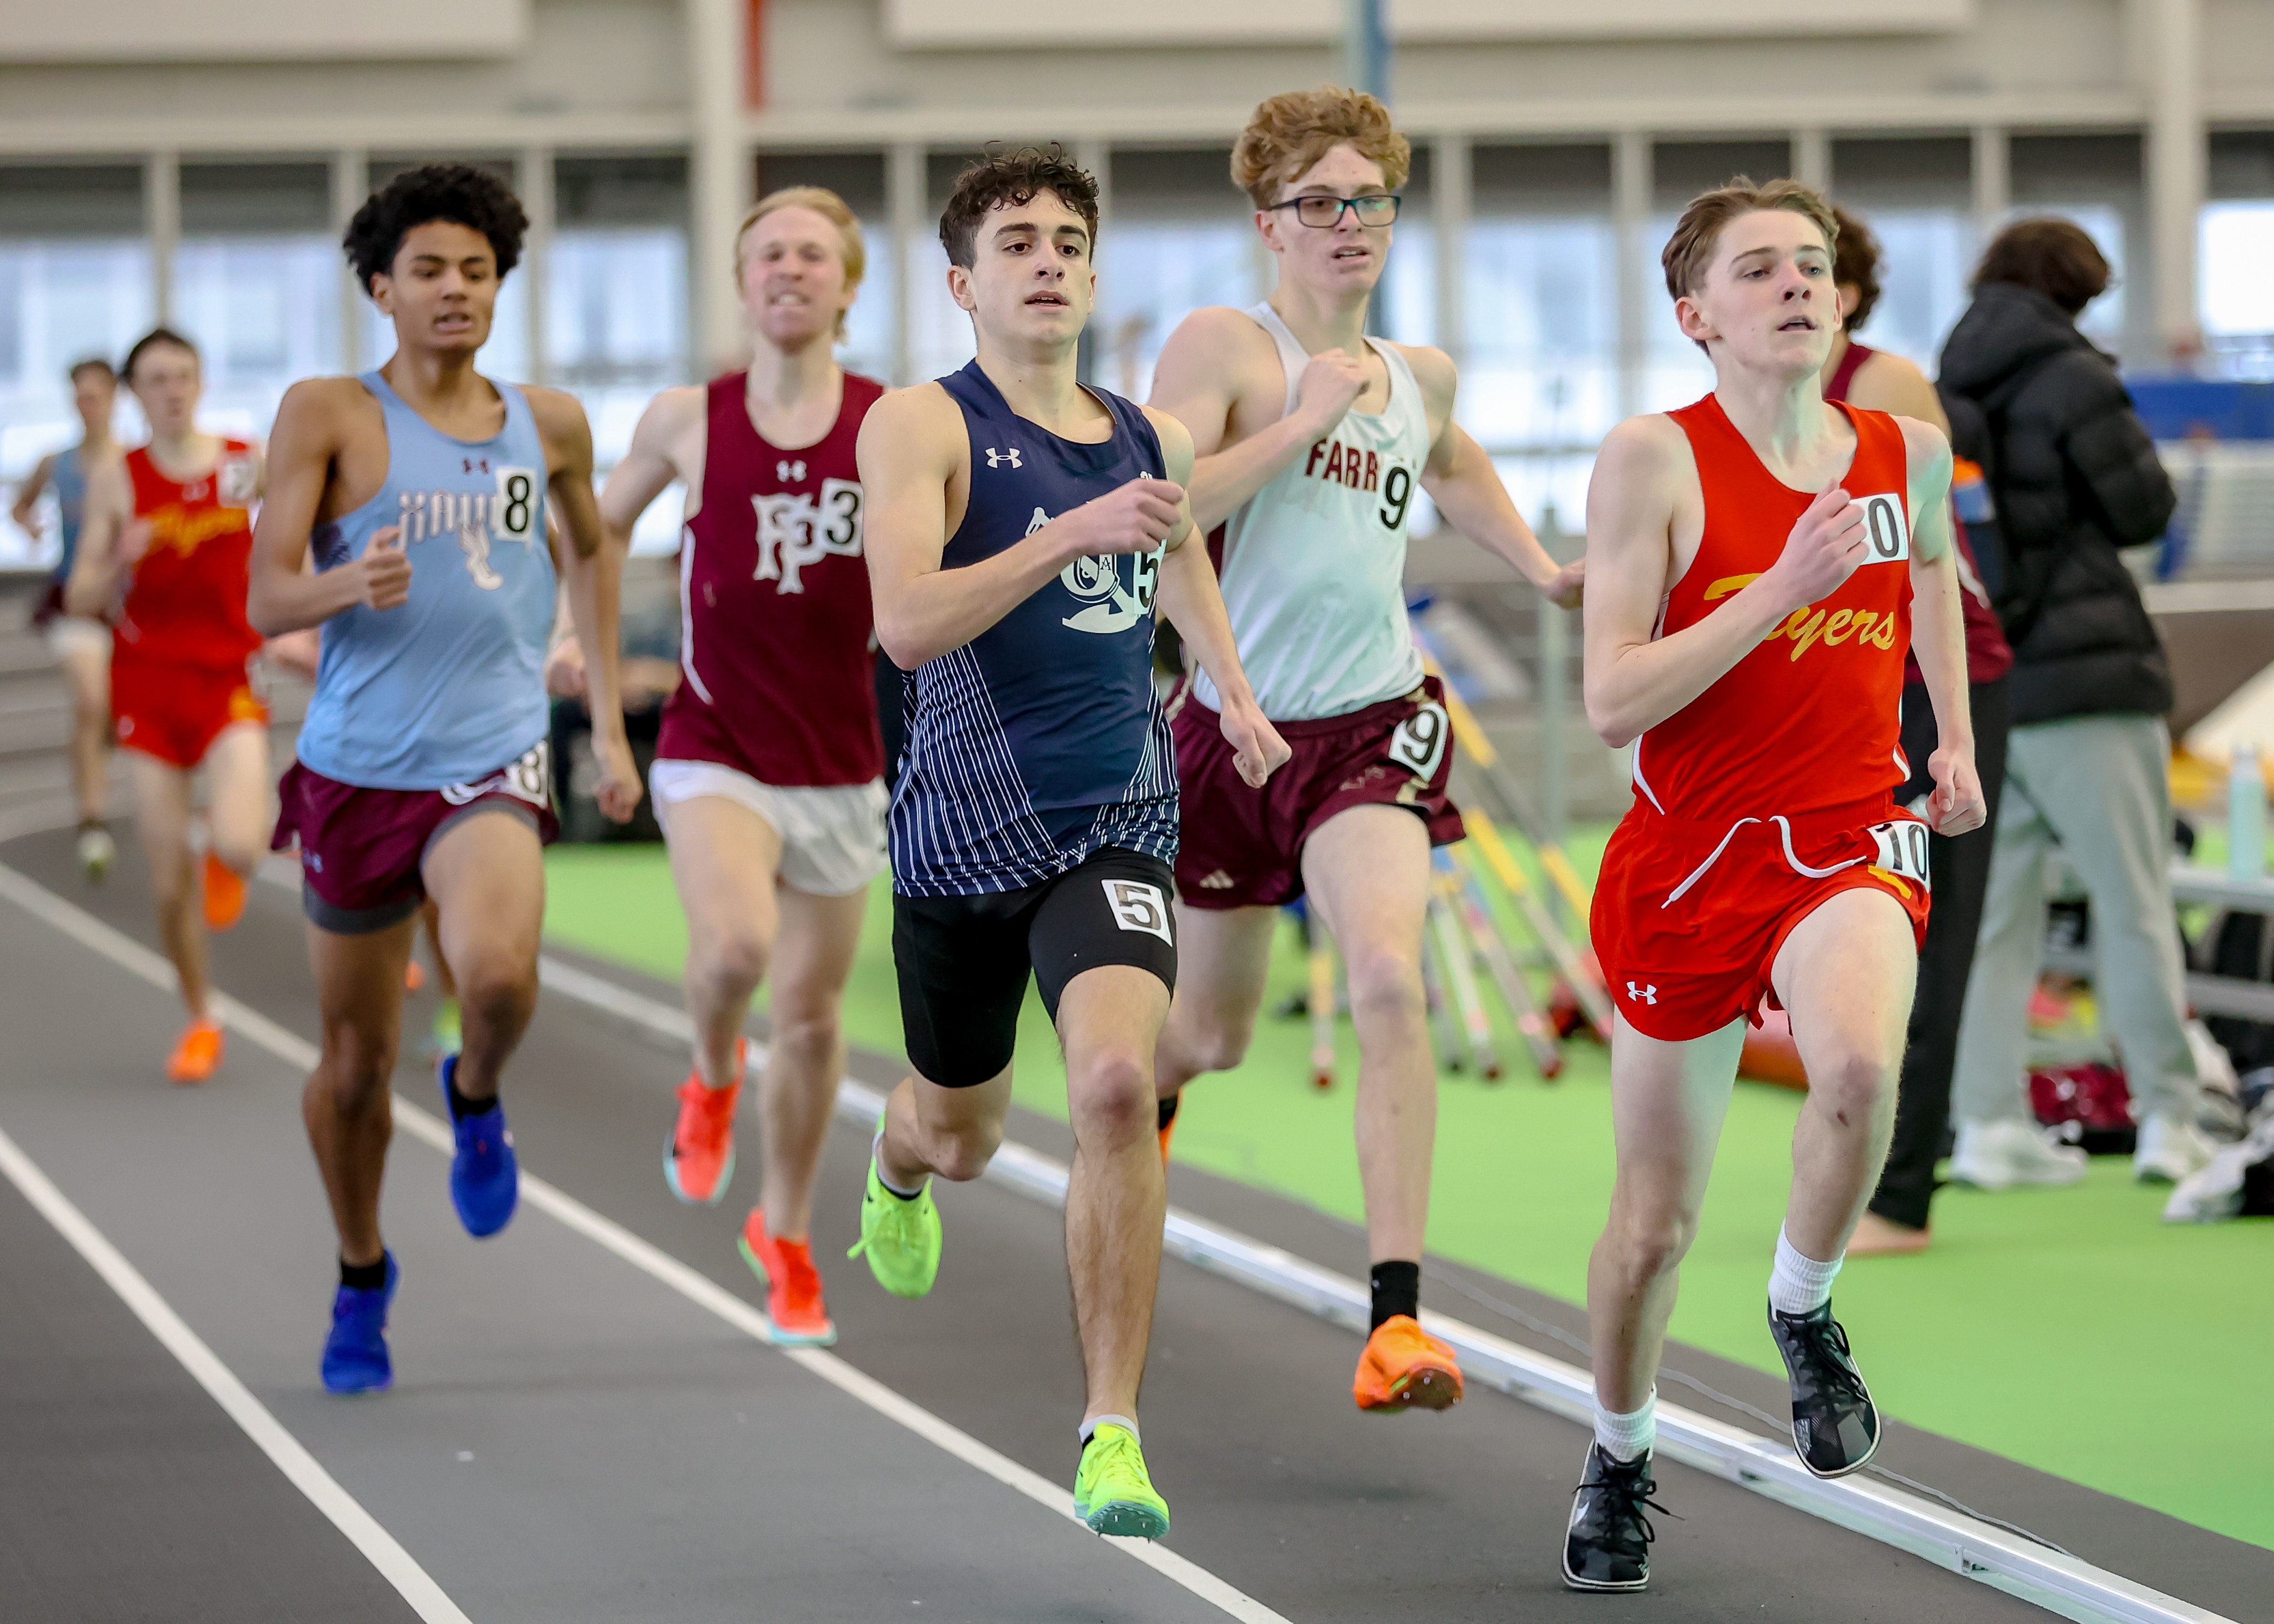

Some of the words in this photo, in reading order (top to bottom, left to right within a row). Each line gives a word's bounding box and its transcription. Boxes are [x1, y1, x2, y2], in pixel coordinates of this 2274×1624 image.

[506, 475, 529, 533] 8
[827, 491, 859, 544] 3
[1380, 466, 1409, 530] 9
[1867, 498, 1899, 558] 0
[1703, 573, 1895, 662] yers
[1402, 710, 1439, 765] 9
[1874, 823, 1927, 881] 10
[1114, 883, 1162, 930] 5
